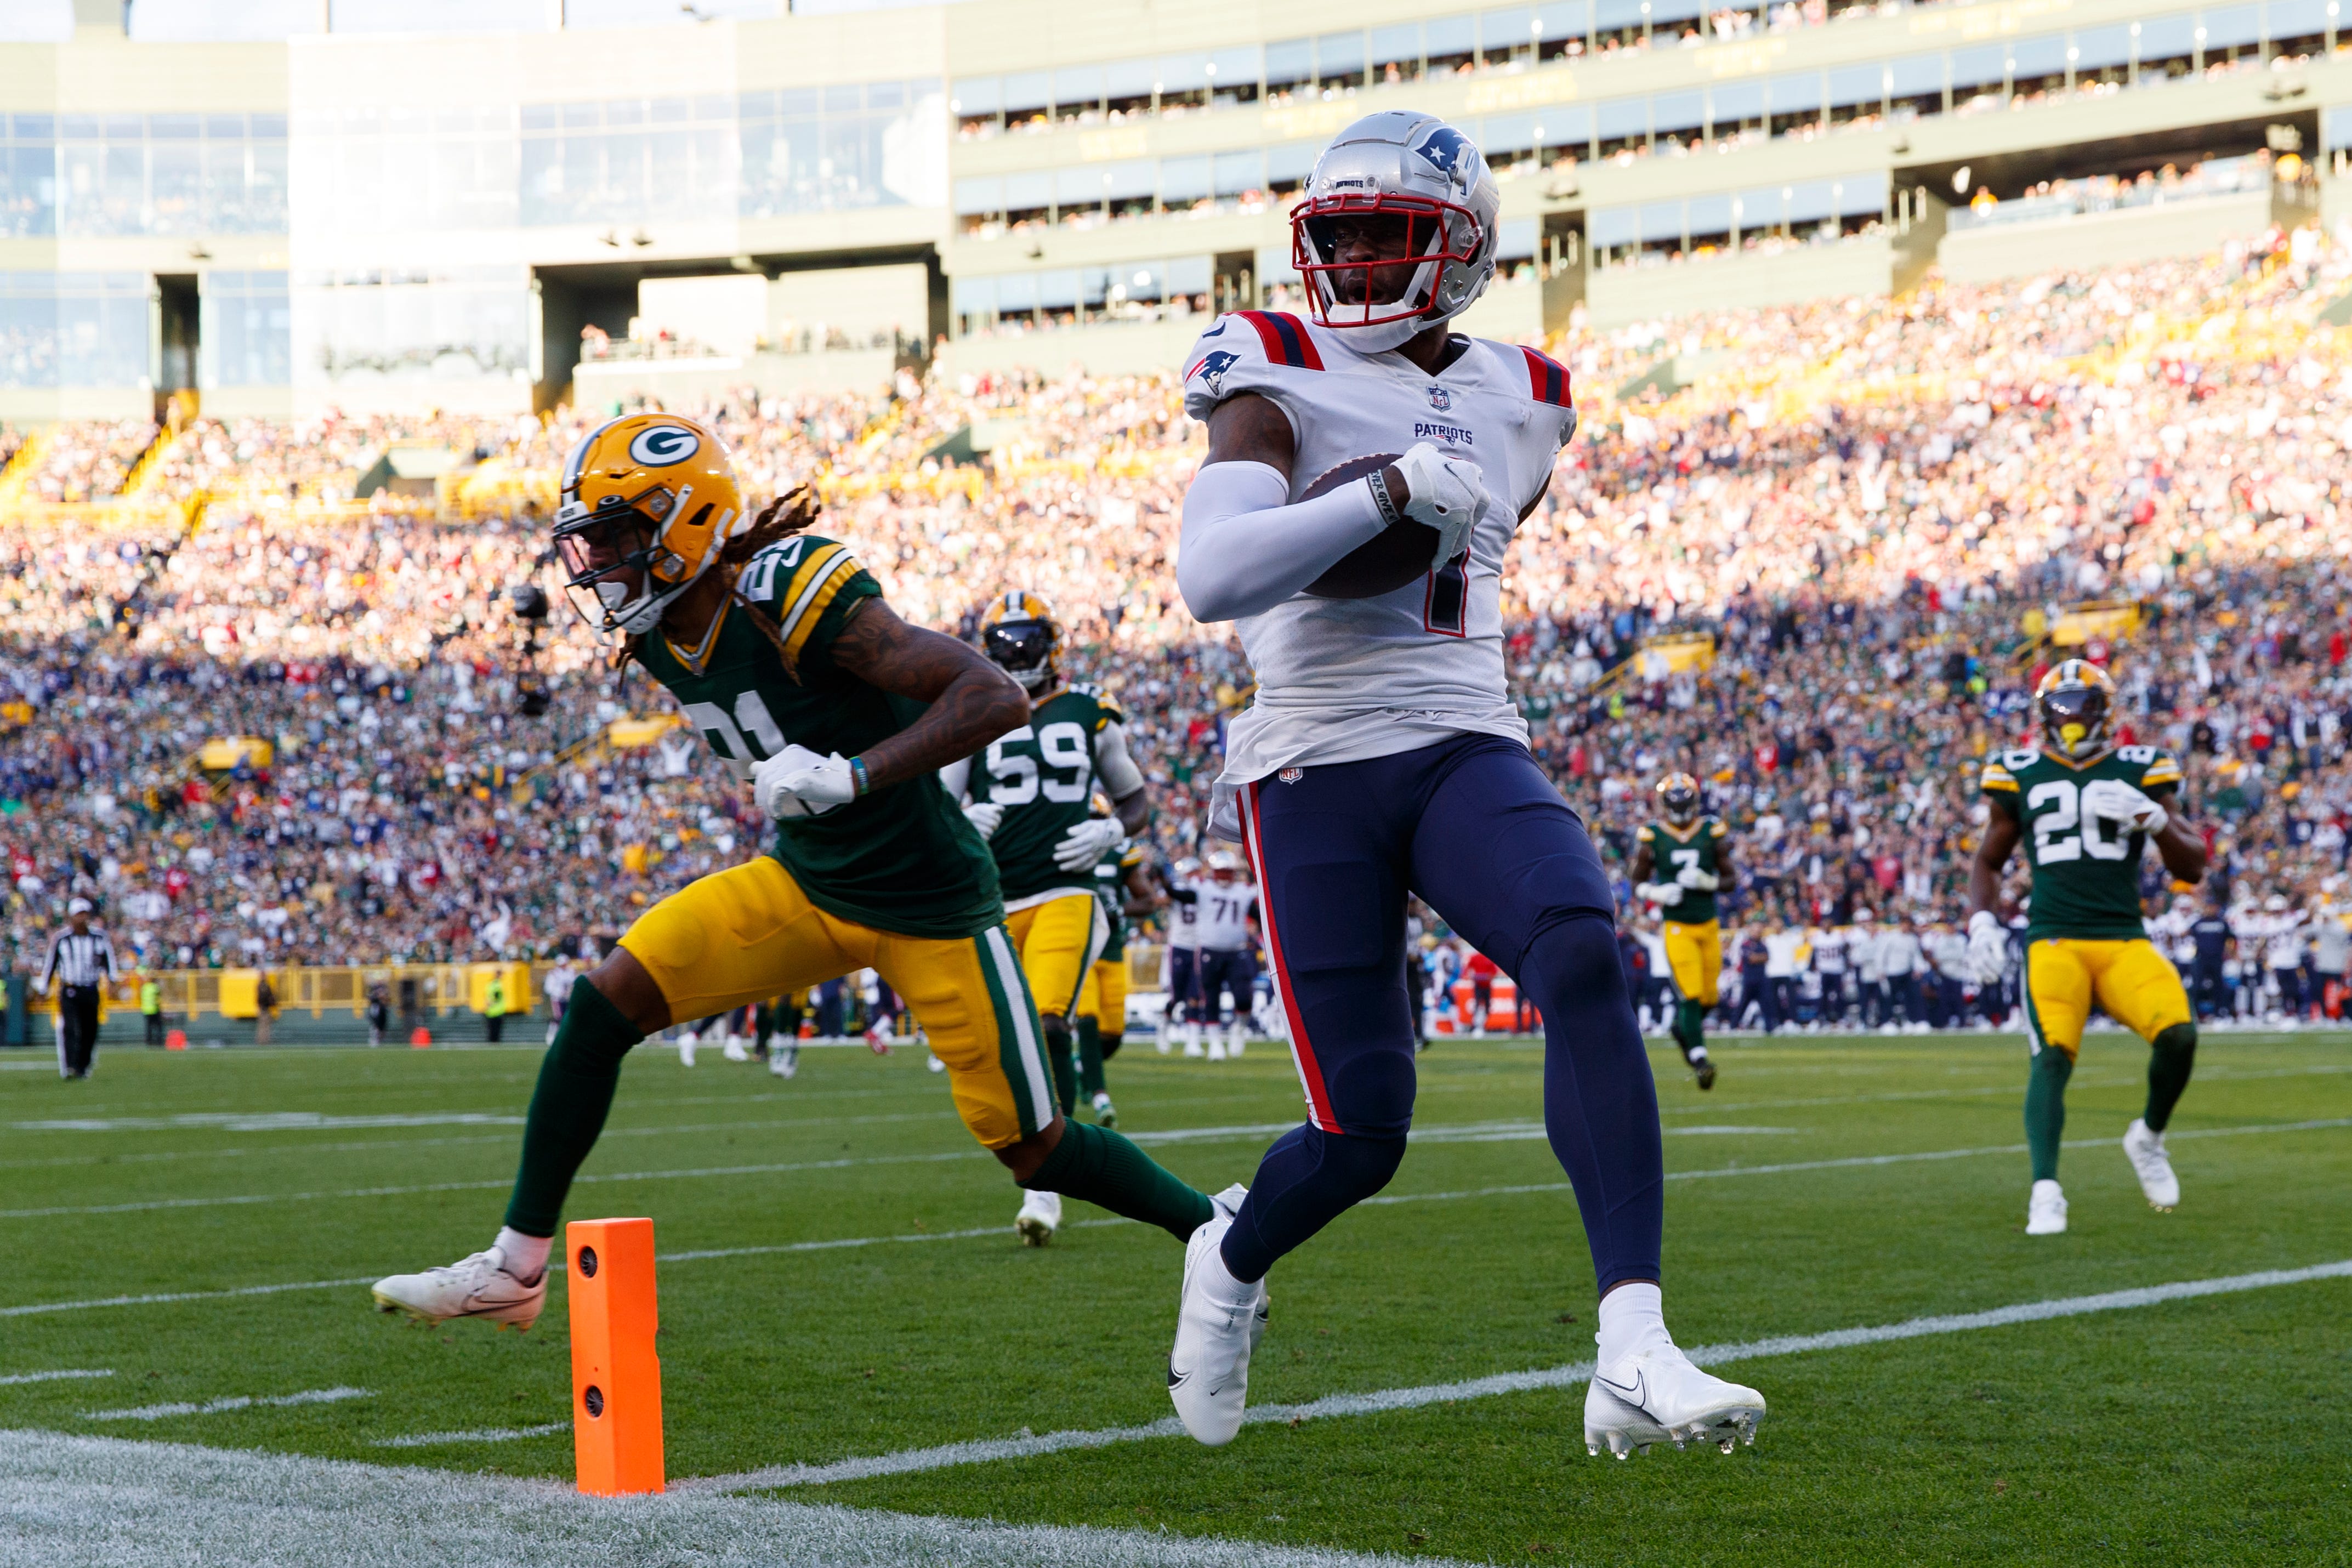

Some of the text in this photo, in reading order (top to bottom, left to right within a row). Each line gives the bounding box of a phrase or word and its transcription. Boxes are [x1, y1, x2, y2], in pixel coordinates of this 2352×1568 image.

[629, 426, 699, 467] G
[1414, 423, 1473, 445] PATRIOTS
[1378, 491, 1395, 514] GIVE
[986, 721, 1092, 805] 59
[2027, 779, 2130, 866] 20
[1211, 896, 1239, 924] 71
